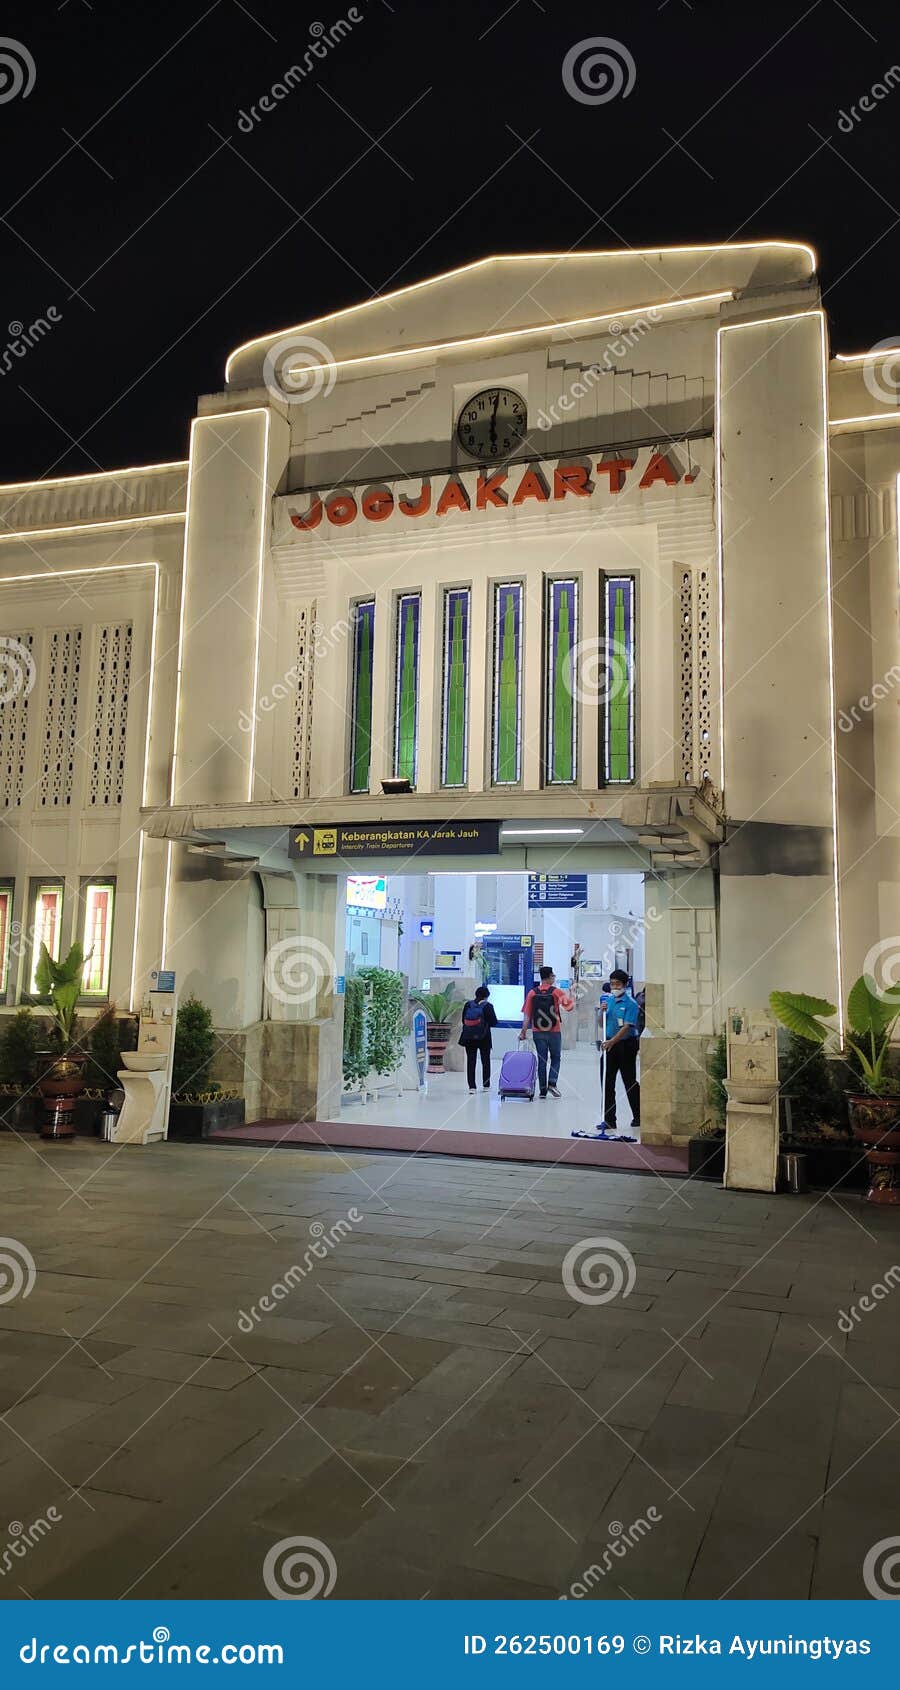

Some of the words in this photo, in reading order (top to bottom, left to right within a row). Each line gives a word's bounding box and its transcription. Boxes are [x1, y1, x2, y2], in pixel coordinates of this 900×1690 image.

[479, 400, 485, 410] 11
[503, 397, 507, 405] 1
[512, 403, 519, 413] 2
[468, 411, 477, 421] 10
[517, 415, 523, 424] 3
[464, 424, 471, 433] 9
[468, 436, 475, 445] 8
[503, 439, 510, 448] 5
[479, 443, 484, 452] 7
[490, 444, 497, 453] 6
[341, 830, 415, 842] Keberangkatan
[416, 830, 430, 838] KA
[431, 829, 456, 838] Jarak
[457, 829, 479, 838] Jauh
